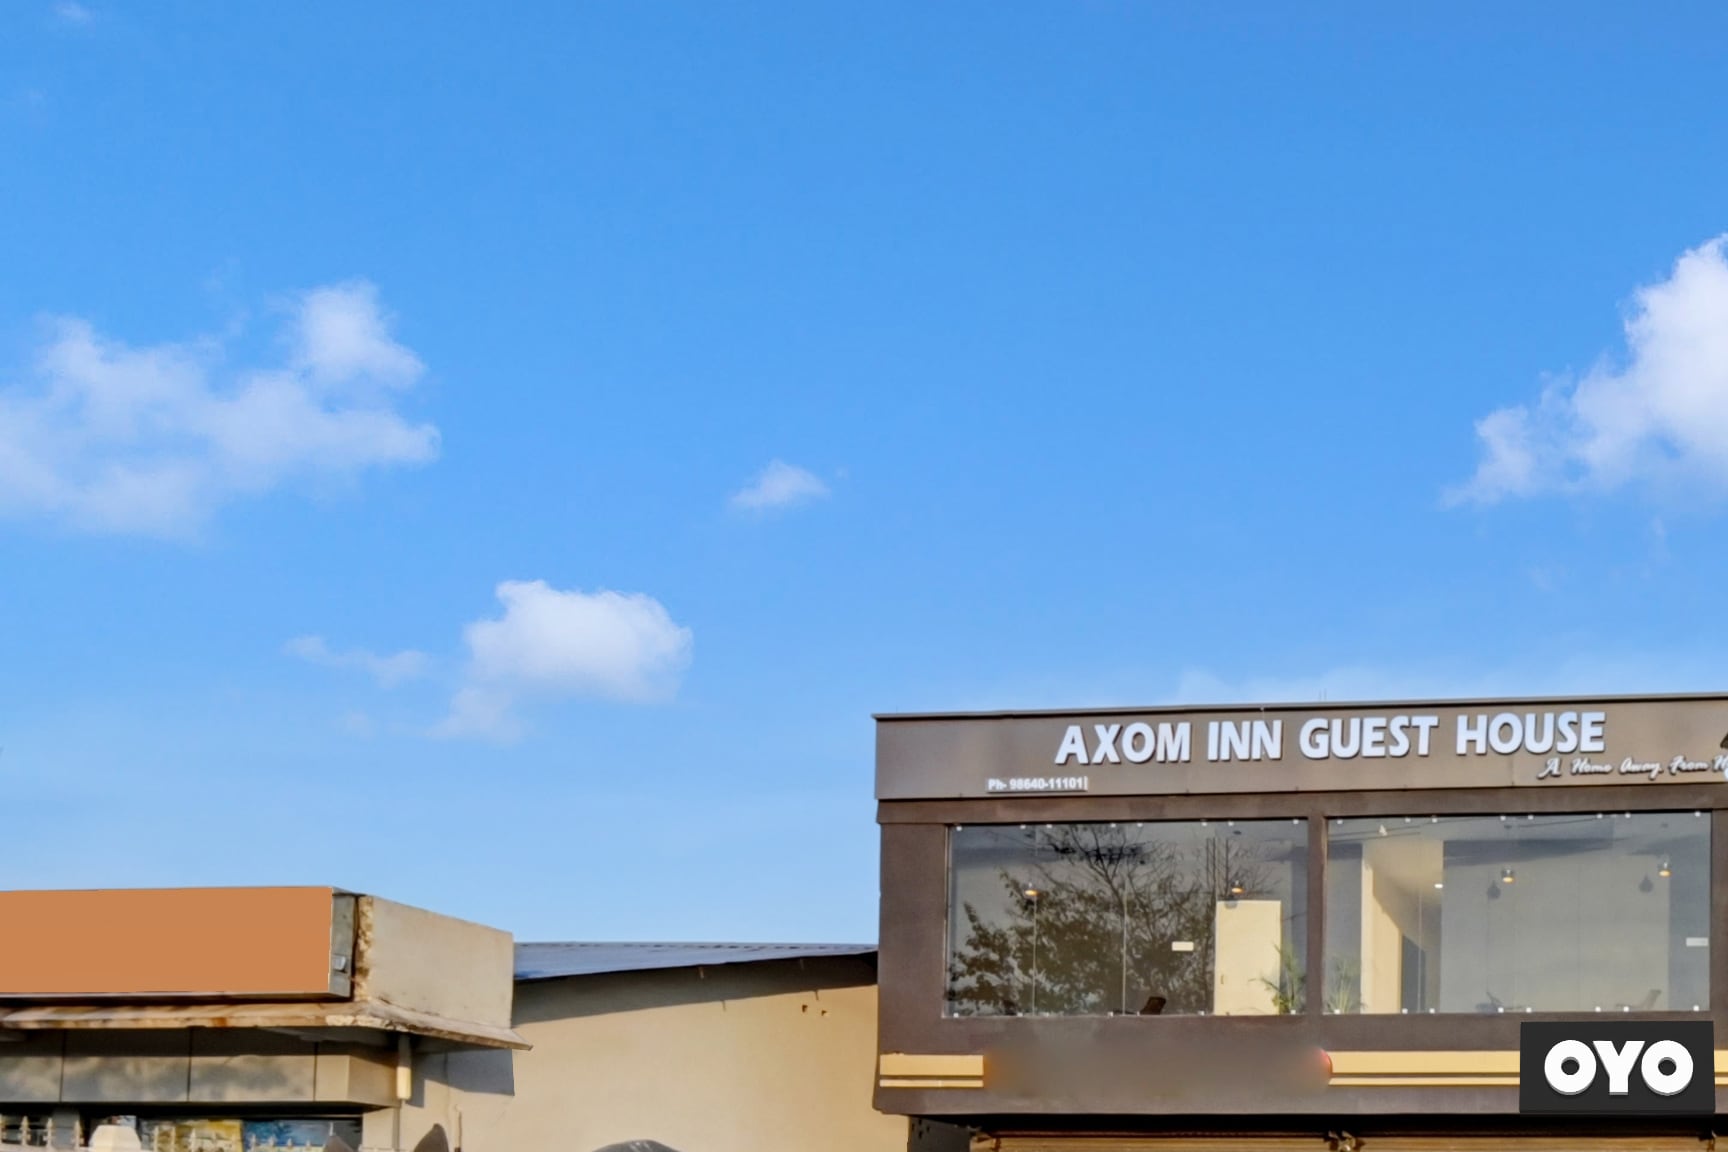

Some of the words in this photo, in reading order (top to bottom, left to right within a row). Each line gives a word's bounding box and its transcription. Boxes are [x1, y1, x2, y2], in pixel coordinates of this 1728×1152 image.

[1054, 721, 1191, 765] AXOM
[1207, 719, 1282, 761] INN
[1299, 715, 1439, 759] GUEST
[1456, 711, 1606, 756] HOUSE
[1537, 757, 1562, 779] A
[1571, 757, 1613, 774] Home
[1669, 755, 1709, 775] From
[1544, 1039, 1694, 1096] OYO
